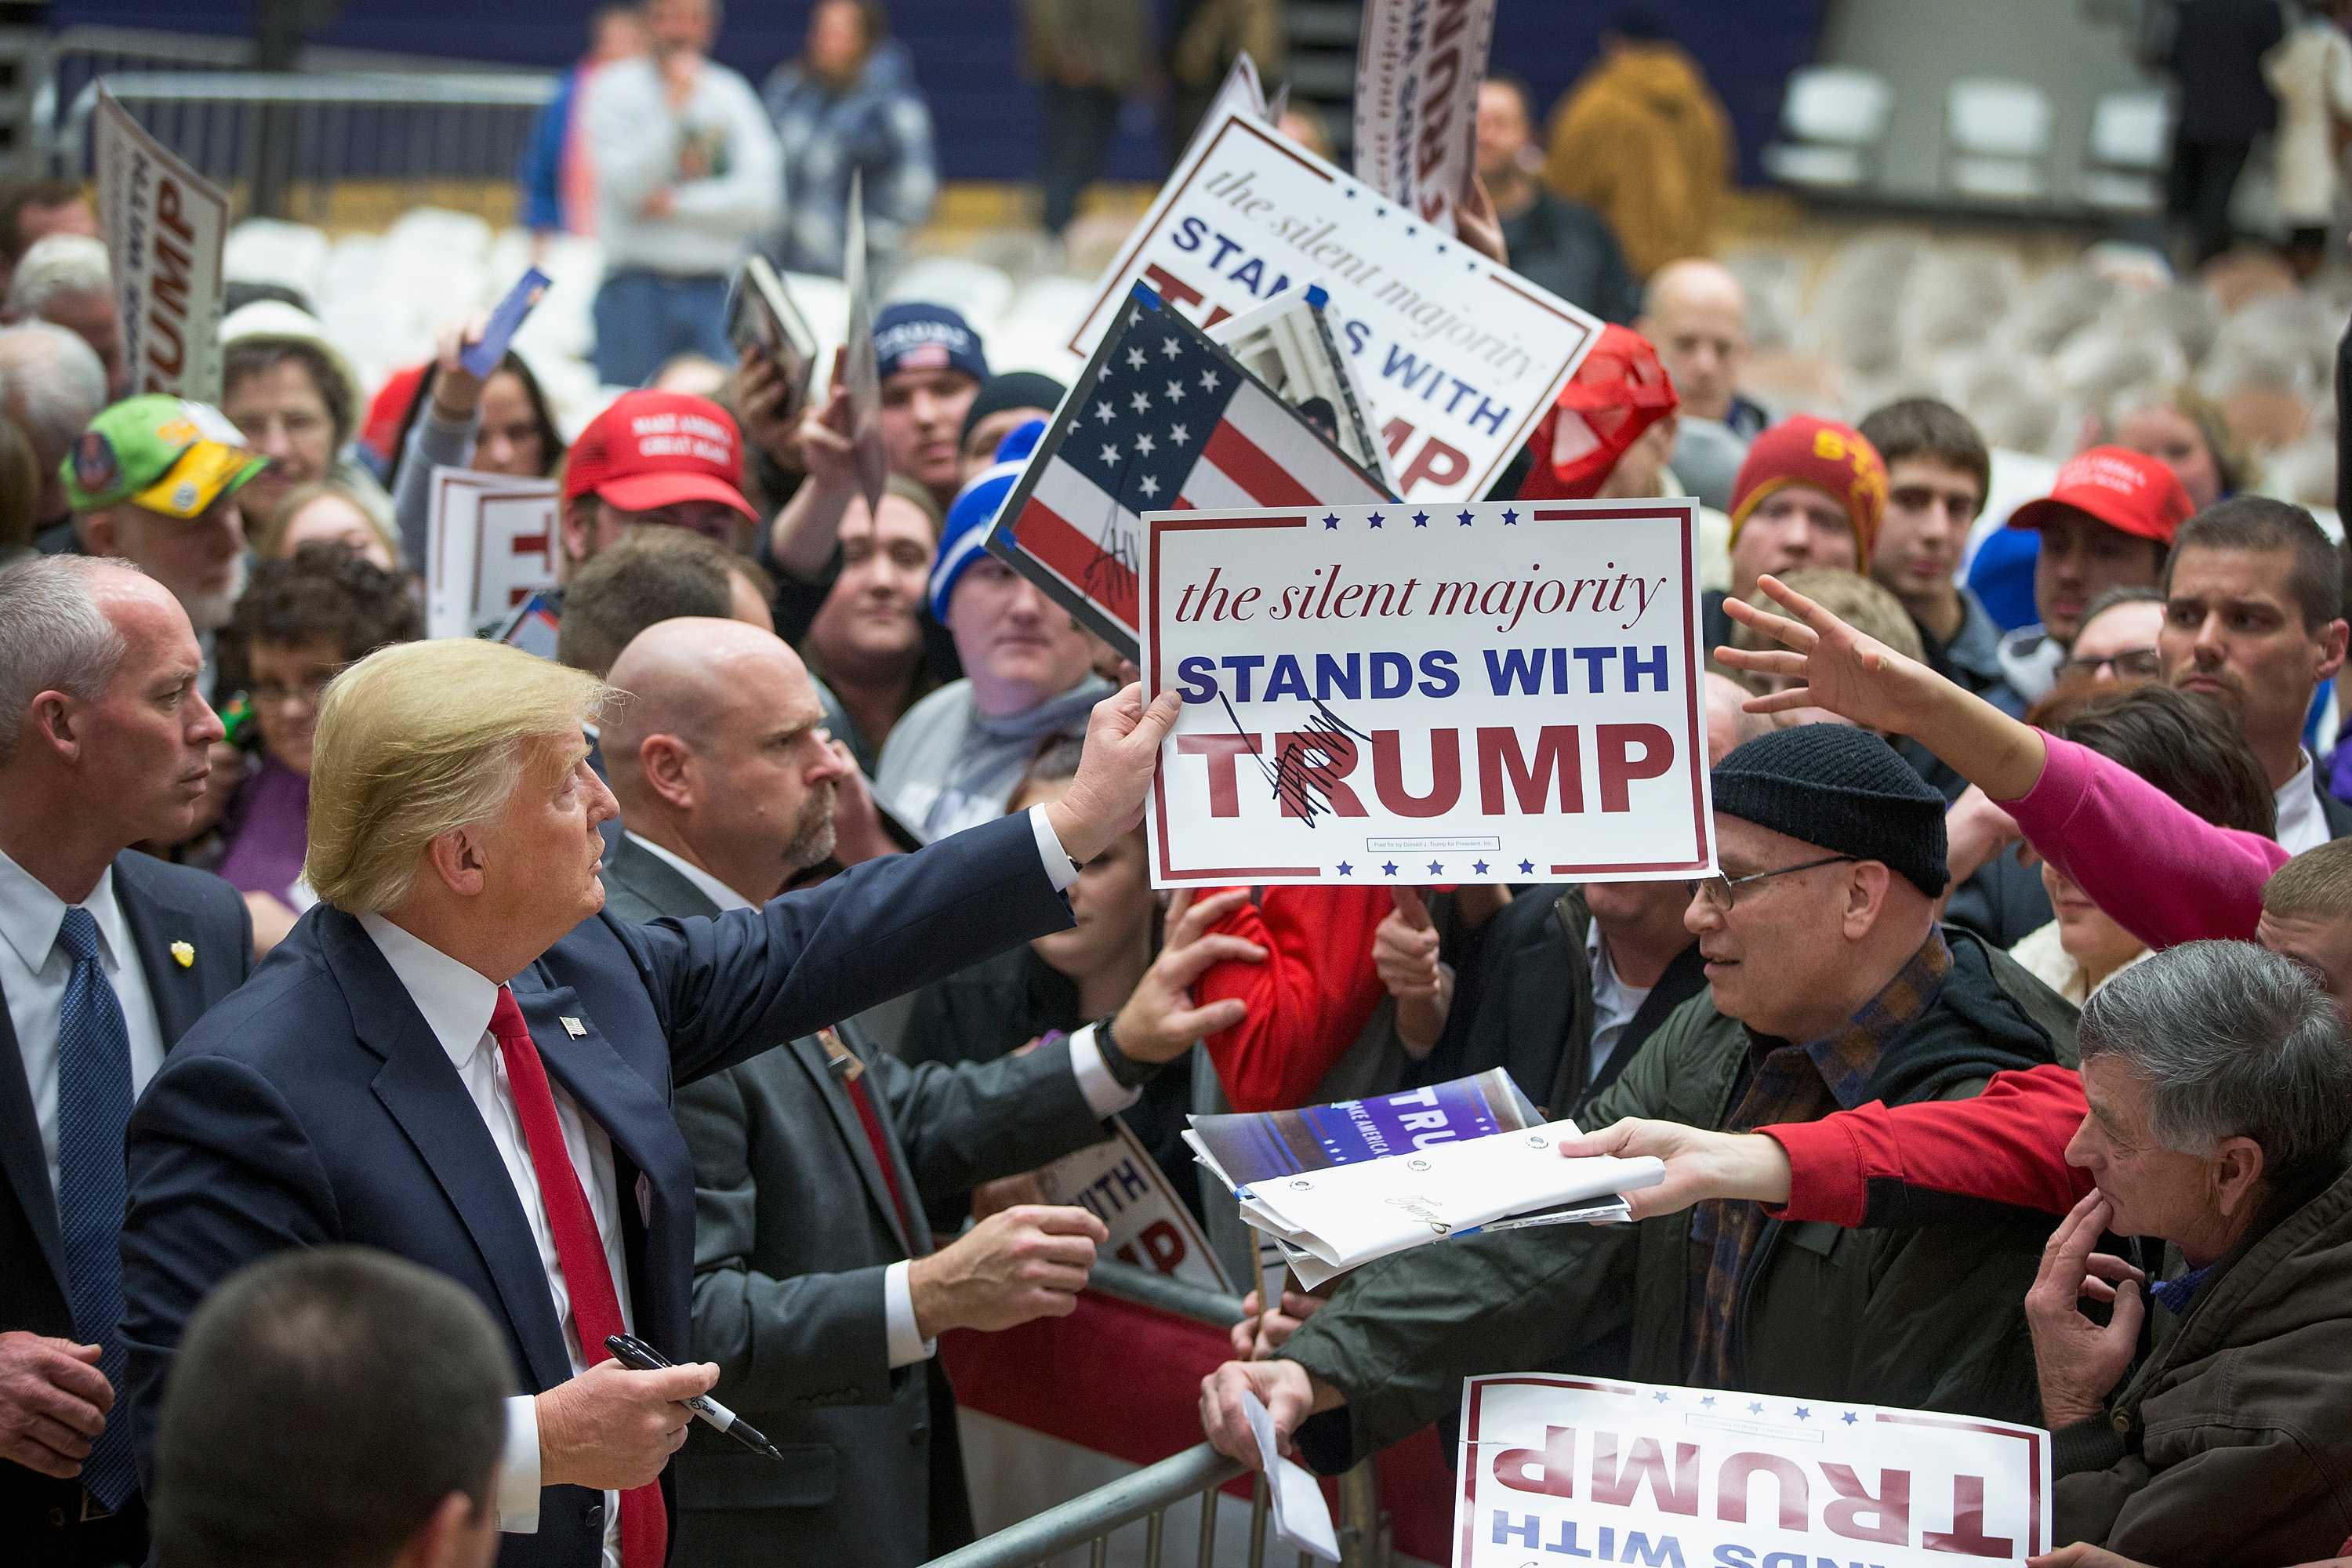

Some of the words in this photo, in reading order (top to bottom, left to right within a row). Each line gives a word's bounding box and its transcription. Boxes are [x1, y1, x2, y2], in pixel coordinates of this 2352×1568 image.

[144, 177, 196, 395] UMP
[1204, 170, 1276, 221] the
[1269, 216, 1382, 285] silent
[1374, 281, 1547, 386] majority
[1381, 343, 1512, 436] WITH
[1176, 567, 1261, 622] the
[1269, 564, 1422, 621] silent
[1428, 562, 1667, 633] majority
[1178, 650, 1461, 704] STANDS
[1483, 644, 1670, 697] WITH
[1177, 723, 1675, 818] TRUMP
[1355, 1120, 1391, 1155] AMERICA
[1388, 1086, 1461, 1149] TRU
[1067, 1157, 1150, 1221] ITH
[1492, 1425, 2013, 1559] TRUMP
[1492, 1510, 1686, 1568] WITH
